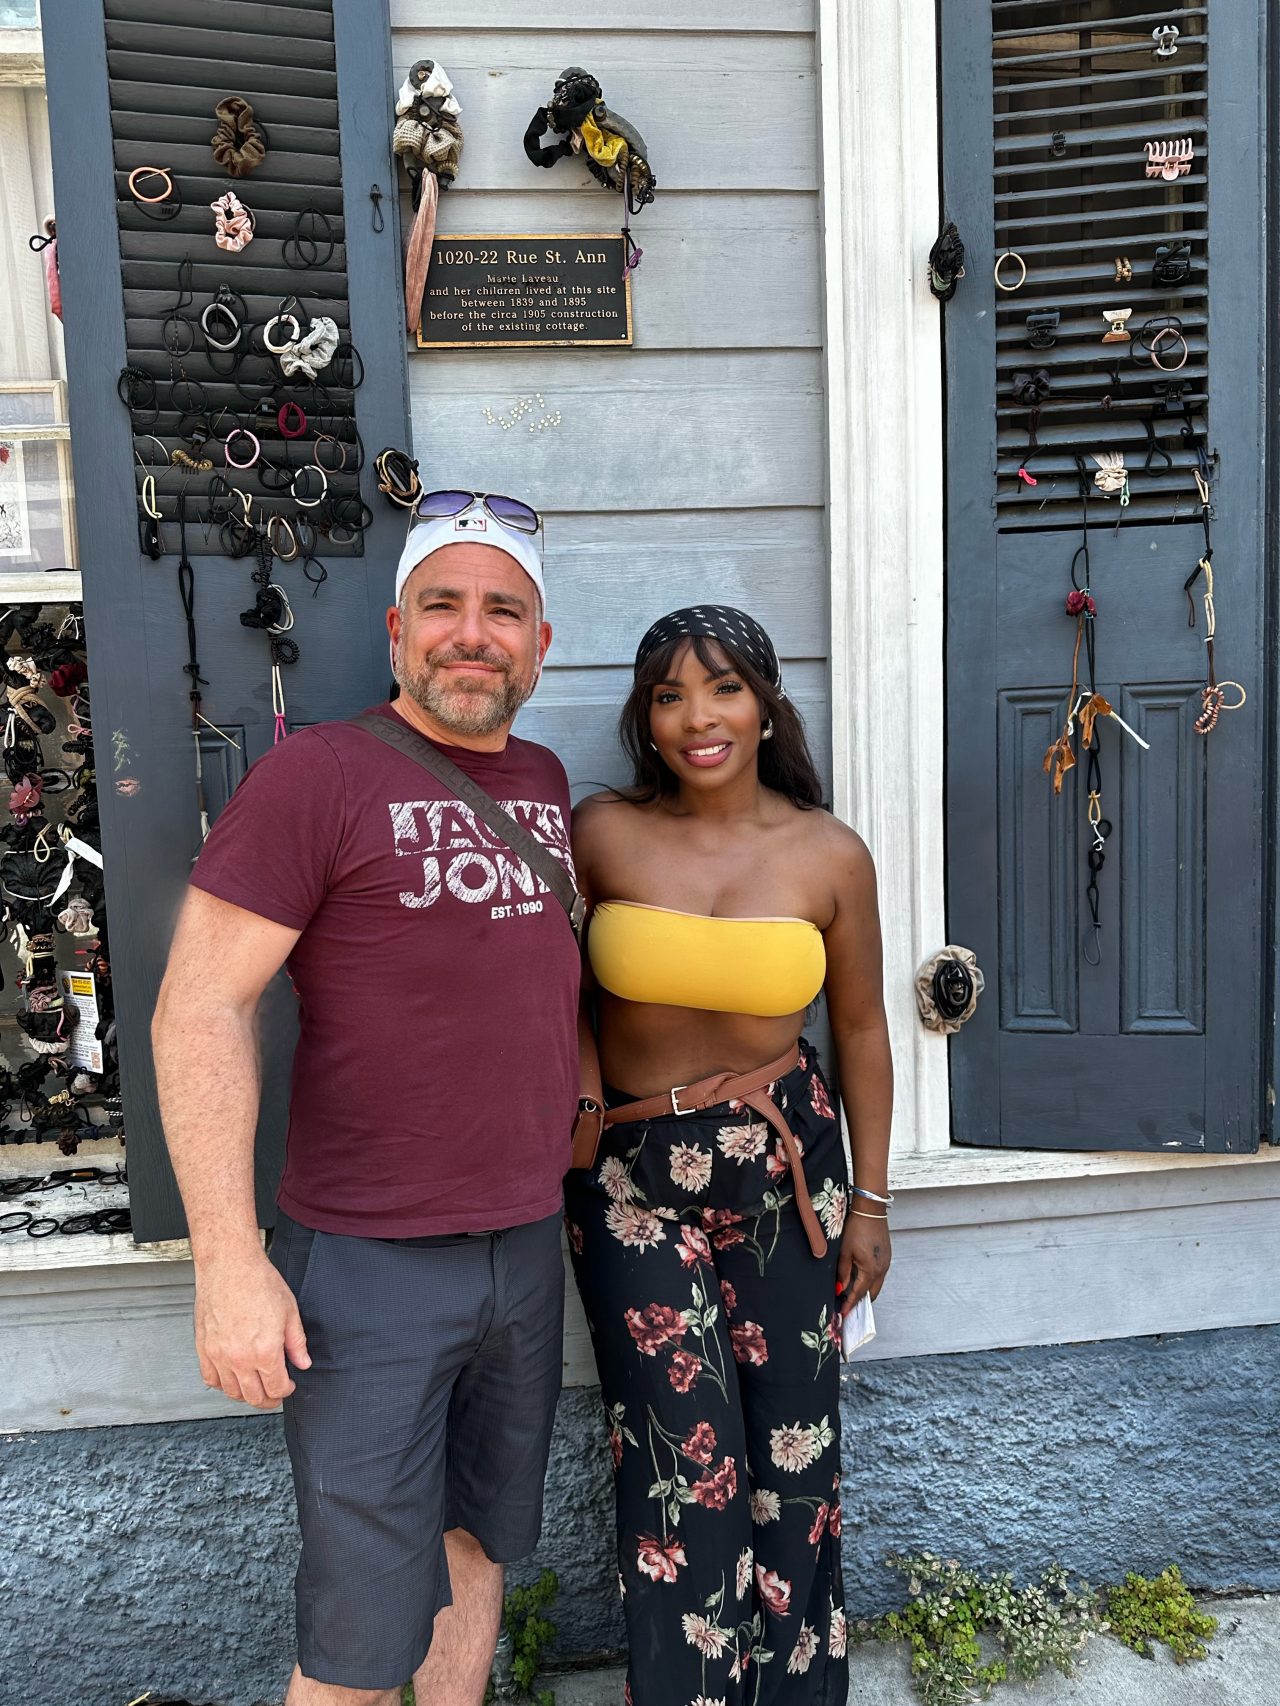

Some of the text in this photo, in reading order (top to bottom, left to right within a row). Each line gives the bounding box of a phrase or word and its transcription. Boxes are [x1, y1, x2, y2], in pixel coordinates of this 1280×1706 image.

[437, 249, 607, 265] 1020-22 Rue St. Ann
[487, 273, 559, 283] Marie Laveau
[429, 285, 617, 296] and her children lived at this site
[461, 296, 587, 308] between 1839 and 1895
[429, 309, 618, 320] before the circa 1905 construction
[461, 322, 588, 333] of the existing cottage.
[400, 851, 551, 909] JON
[491, 900, 543, 920] EST. 1990
